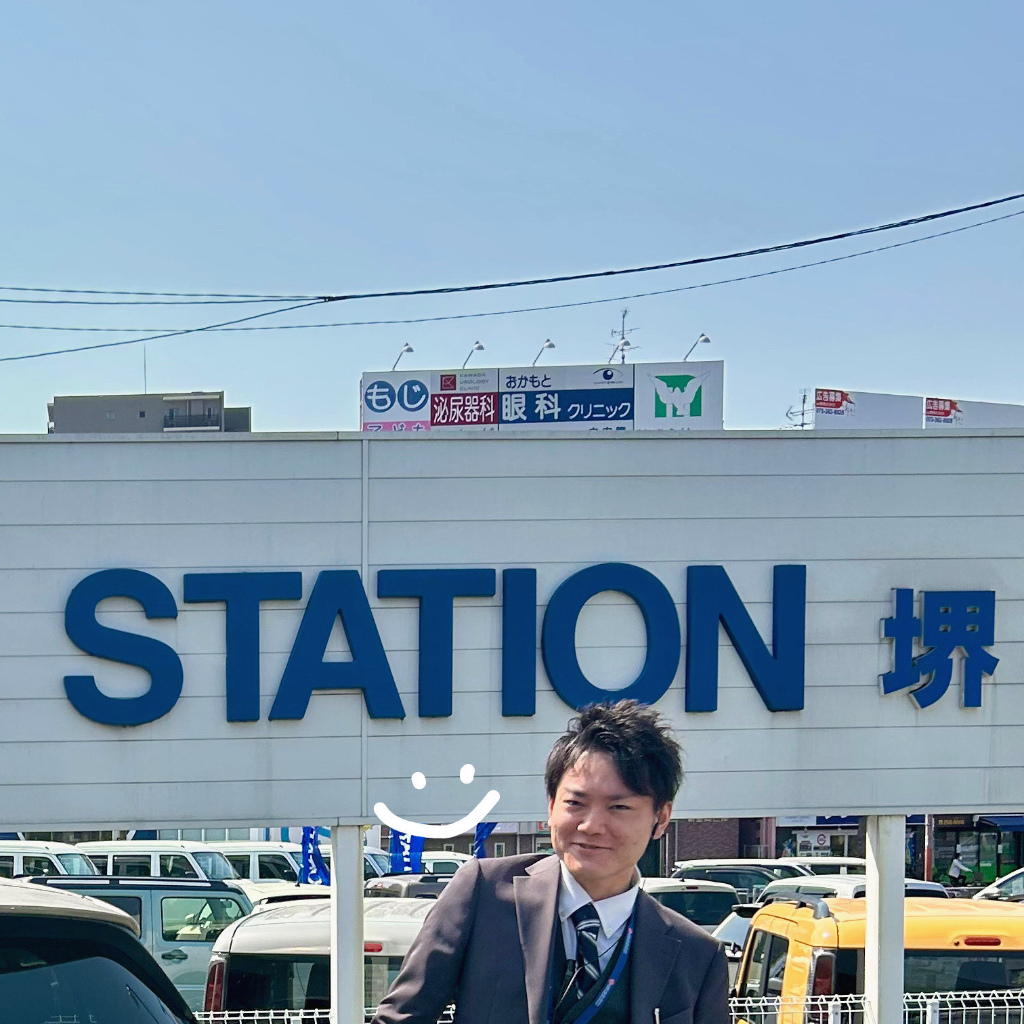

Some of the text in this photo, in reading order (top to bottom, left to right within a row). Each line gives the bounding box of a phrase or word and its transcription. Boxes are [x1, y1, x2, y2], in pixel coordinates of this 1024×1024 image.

[505, 374, 552, 389] おかもと
[366, 384, 426, 410] もじ
[433, 394, 495, 423] 泌尿器科
[63, 561, 807, 727] STATION
[879, 586, 1000, 710] 堺
